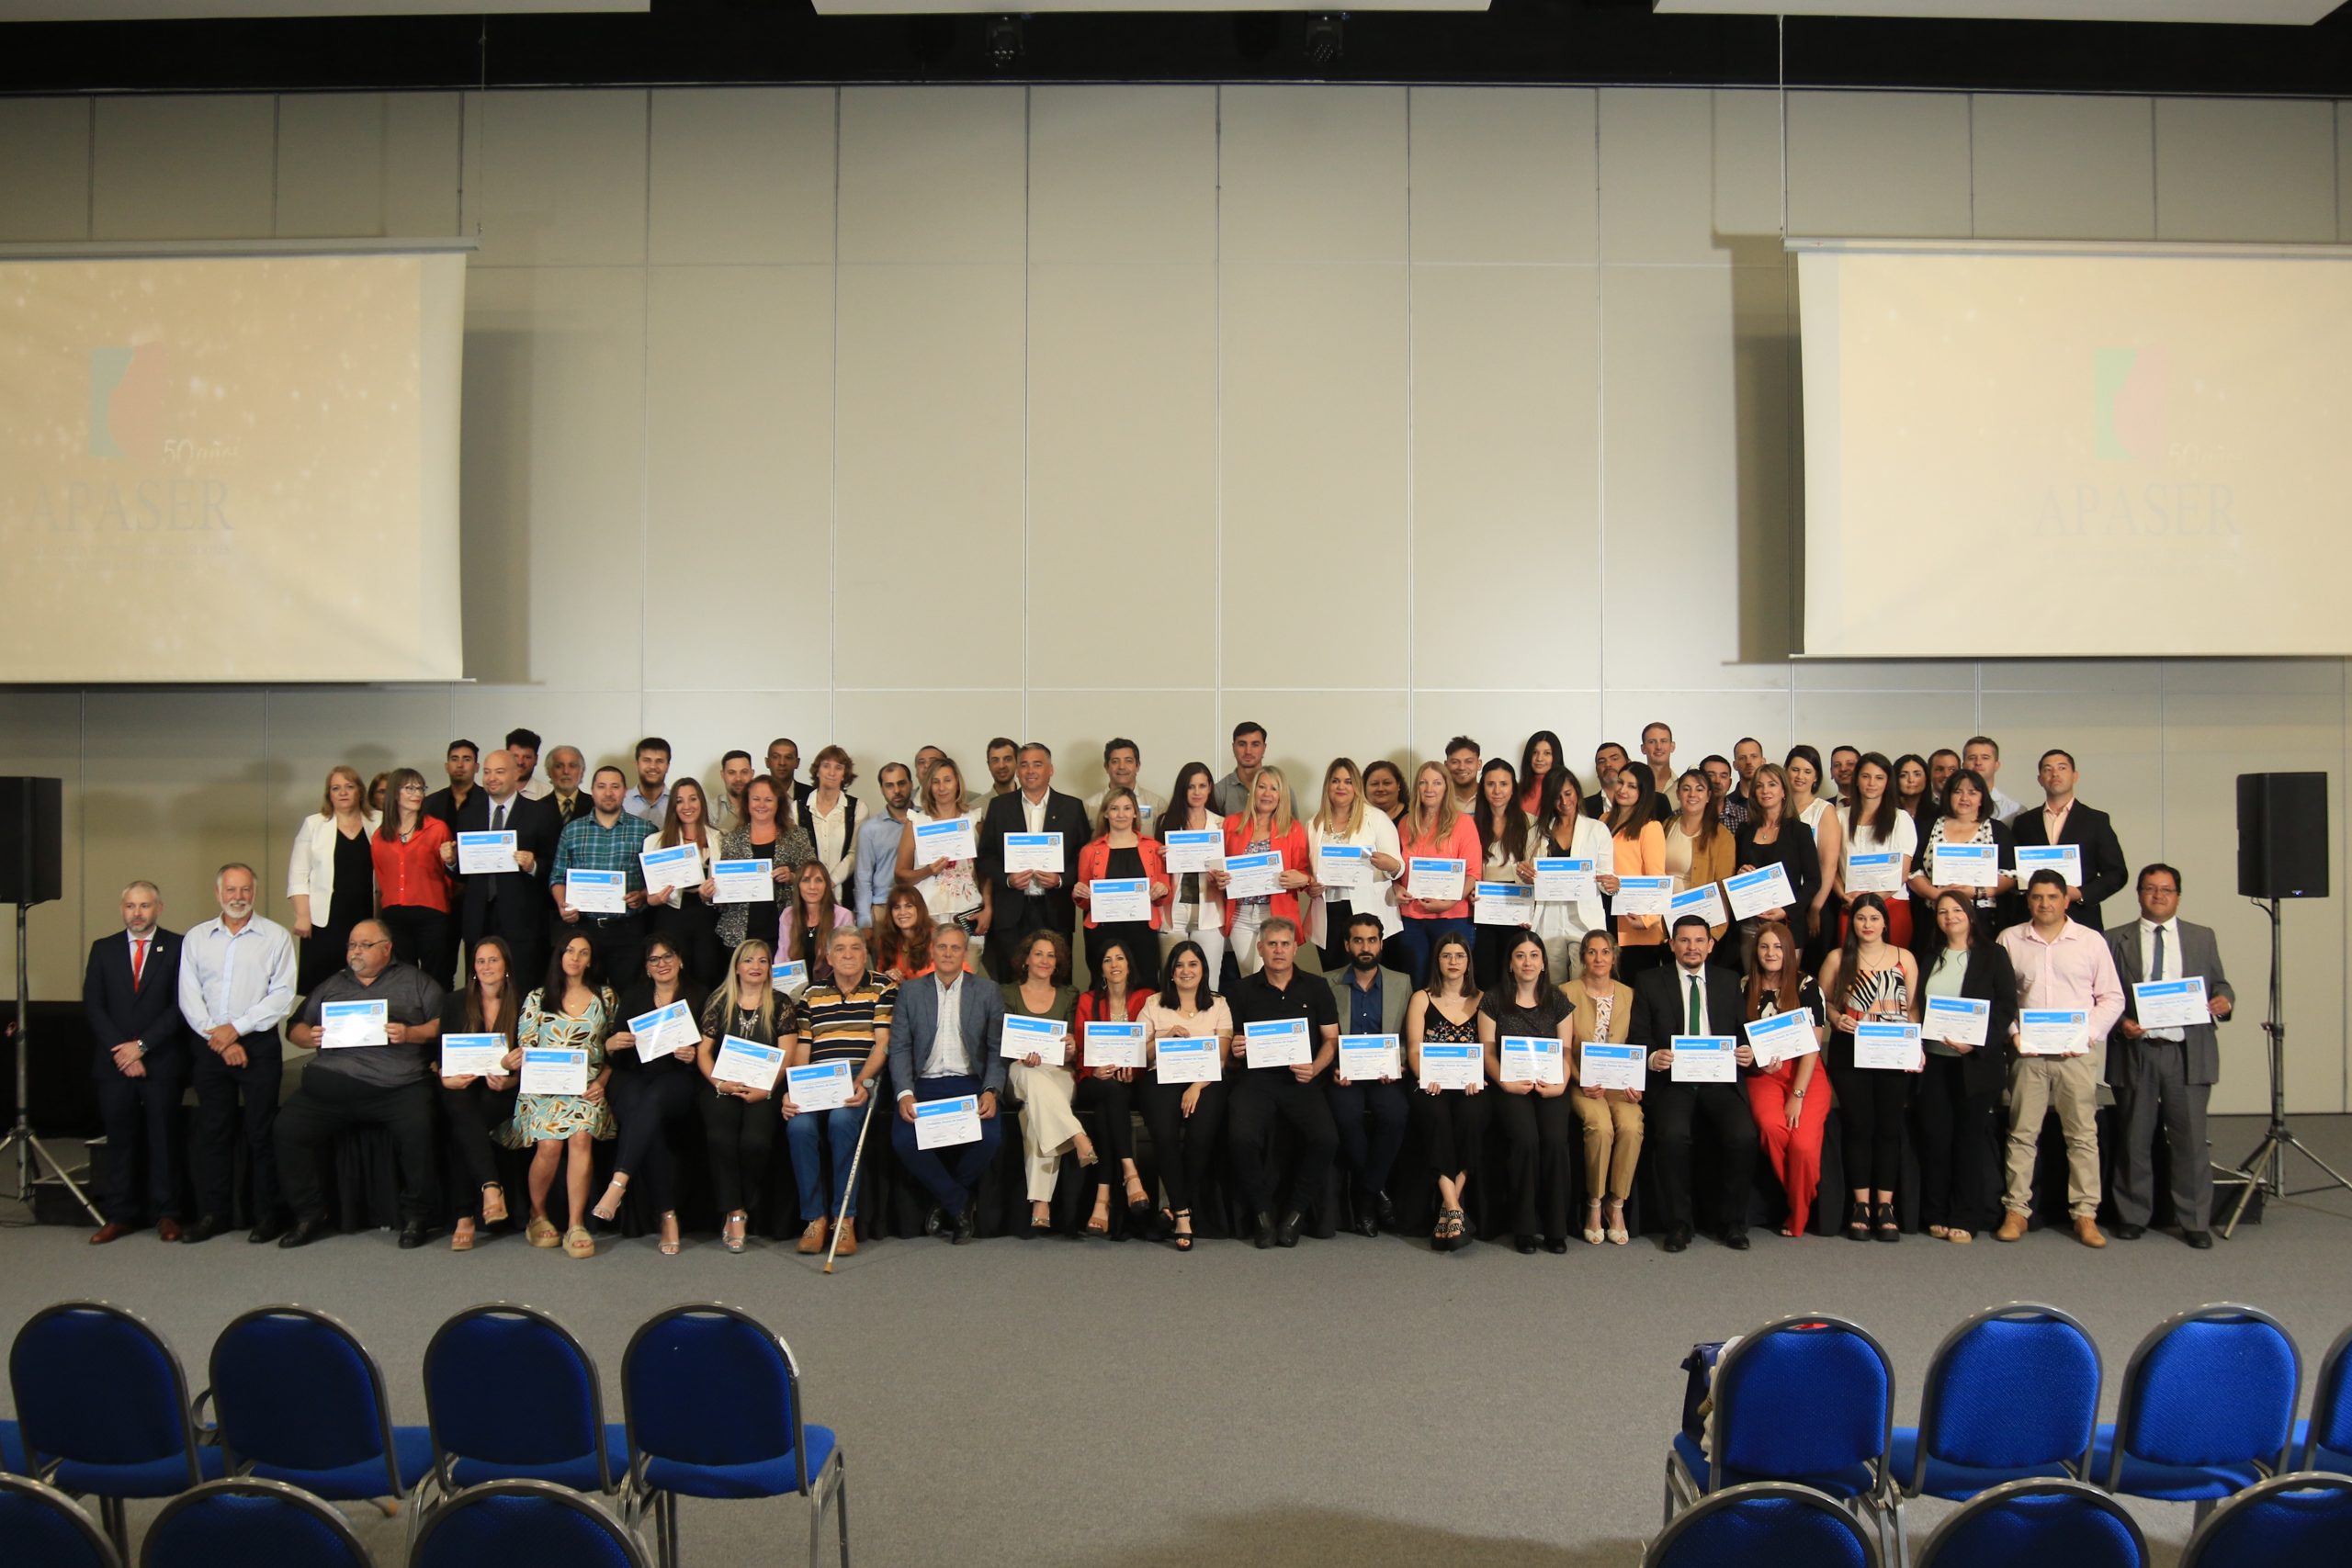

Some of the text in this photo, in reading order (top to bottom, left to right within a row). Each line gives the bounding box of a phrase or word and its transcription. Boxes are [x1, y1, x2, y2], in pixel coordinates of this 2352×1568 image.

[163, 439, 194, 464] 50
[25, 479, 235, 533] APASER
[2031, 482, 2241, 536] APASER
